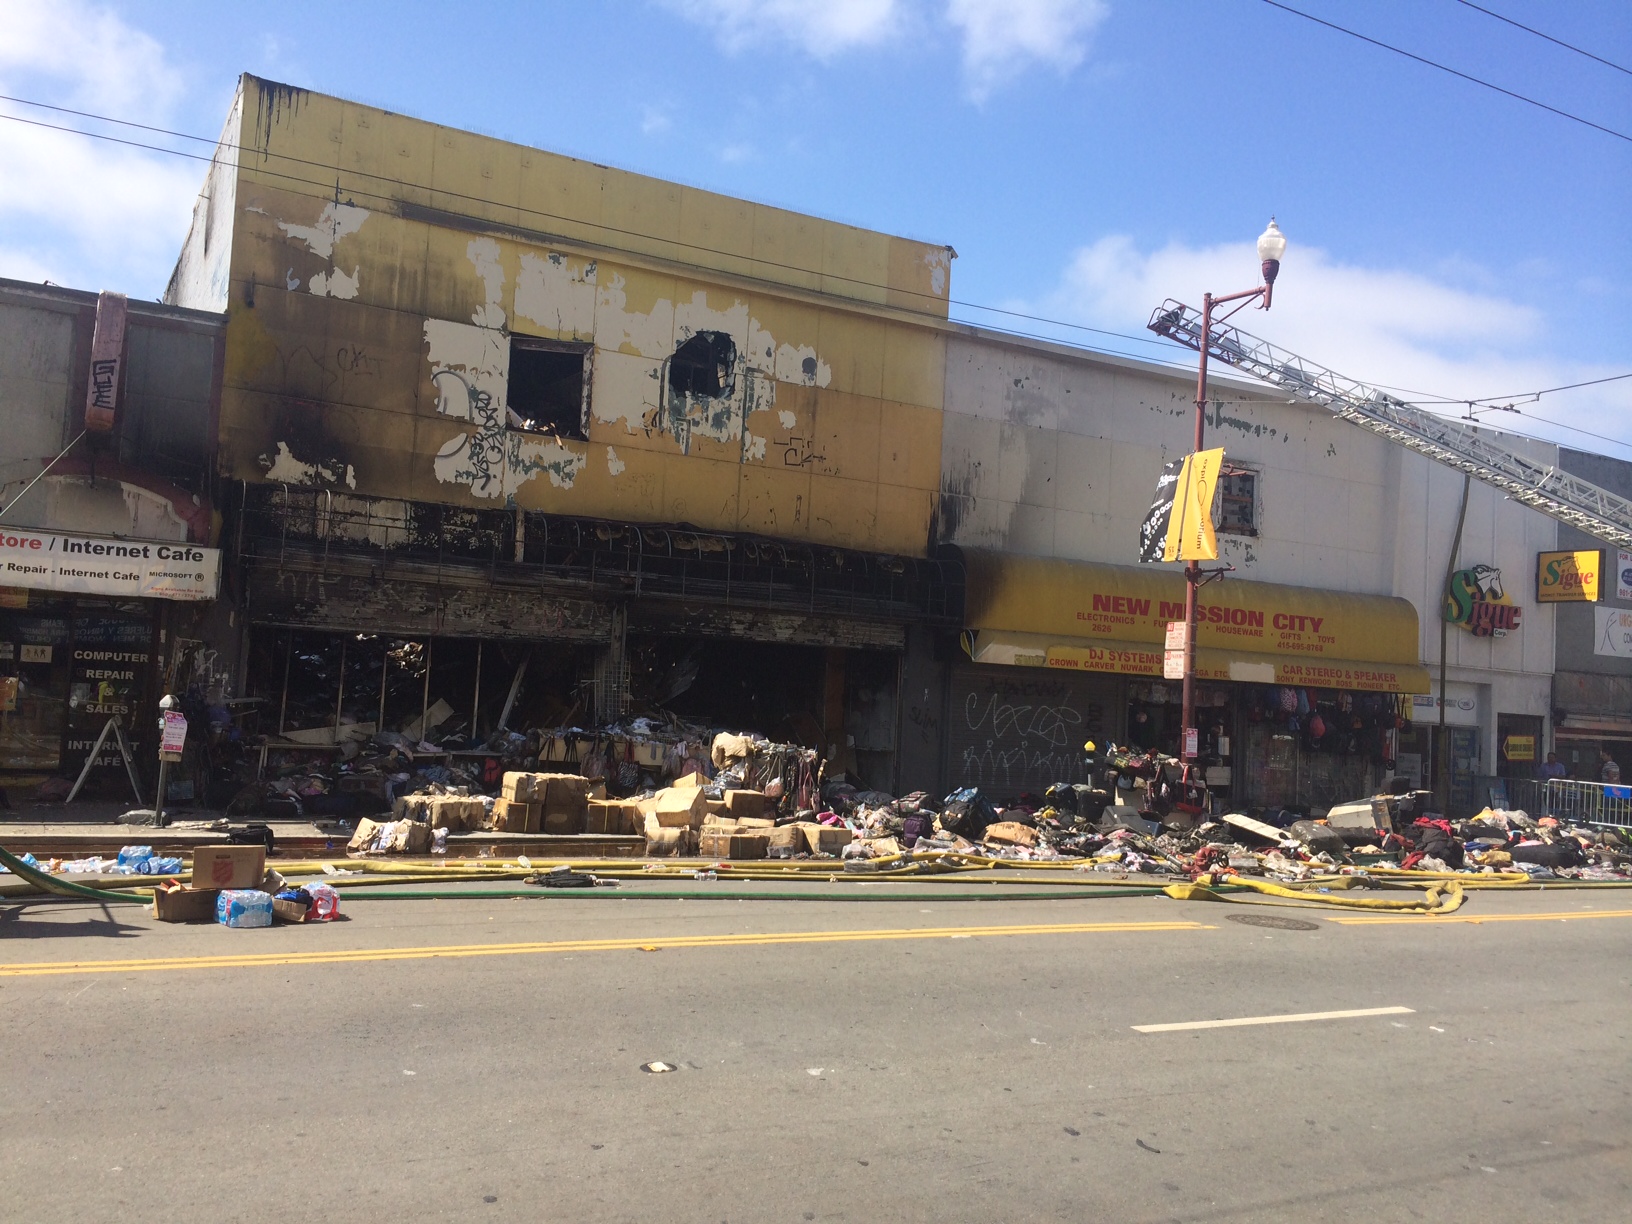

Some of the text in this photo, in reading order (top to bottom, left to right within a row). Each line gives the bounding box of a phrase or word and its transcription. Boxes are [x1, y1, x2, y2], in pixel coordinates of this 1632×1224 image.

[63, 538, 150, 558] Internet
[157, 546, 204, 562] Cafe
[1619, 553, 1628, 561] FOR
[7, 562, 48, 574] Repair
[60, 567, 109, 579] Internet
[113, 571, 140, 581] Cafe
[149, 571, 193, 579] MICROSOFT
[1543, 559, 1594, 590] Sigue
[1446, 569, 1522, 637] Sigue
[1076, 612, 1136, 625] ELECTRONICS
[1092, 594, 1151, 616] NEW
[1272, 613, 1324, 633] CITY
[1091, 623, 1112, 633] 2626
[1215, 626, 1336, 644] HOUSEWARE GIFTS TOYS
[74, 650, 149, 662] COMPUTER
[1089, 648, 1104, 661] DJ
[1108, 650, 1162, 665] SYSTEMS
[1049, 658, 1079, 668] CROWN
[1084, 660, 1116, 671] CARVER
[1120, 663, 1154, 673] NUWARK
[85, 669, 134, 680] REPAIR
[1282, 665, 1397, 682] CAR STEREO & SPEAKER
[1276, 675, 1295, 683] SONY
[1299, 677, 1332, 686] KENWOOD
[1335, 679, 1353, 688] BOSS
[1356, 681, 1384, 690] PIONEER
[104, 687, 114, 697] &
[85, 703, 129, 714] SALES
[68, 740, 140, 751] INTRNT
